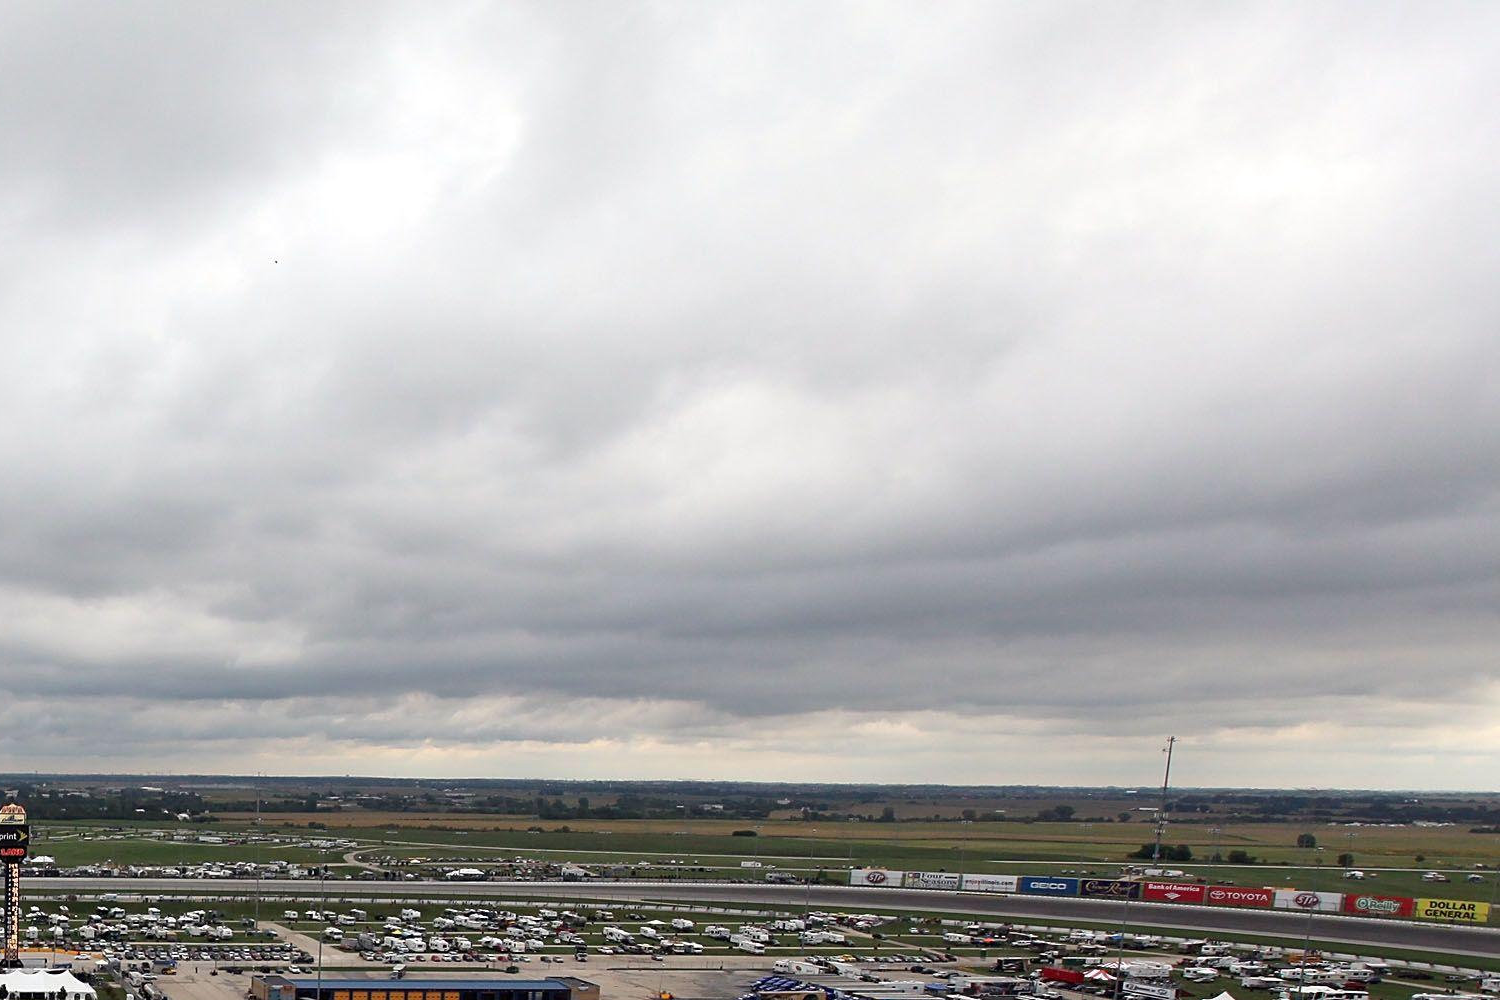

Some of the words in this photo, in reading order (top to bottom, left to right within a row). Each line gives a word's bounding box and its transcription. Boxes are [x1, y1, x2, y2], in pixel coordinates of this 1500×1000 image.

[868, 871, 886, 882] STP
[1030, 882, 1067, 890] GEICO
[1226, 892, 1268, 901] TOYOTA
[1297, 895, 1317, 905] STP
[1429, 901, 1476, 911] DOLLAR
[1424, 909, 1477, 919] GENERAL
